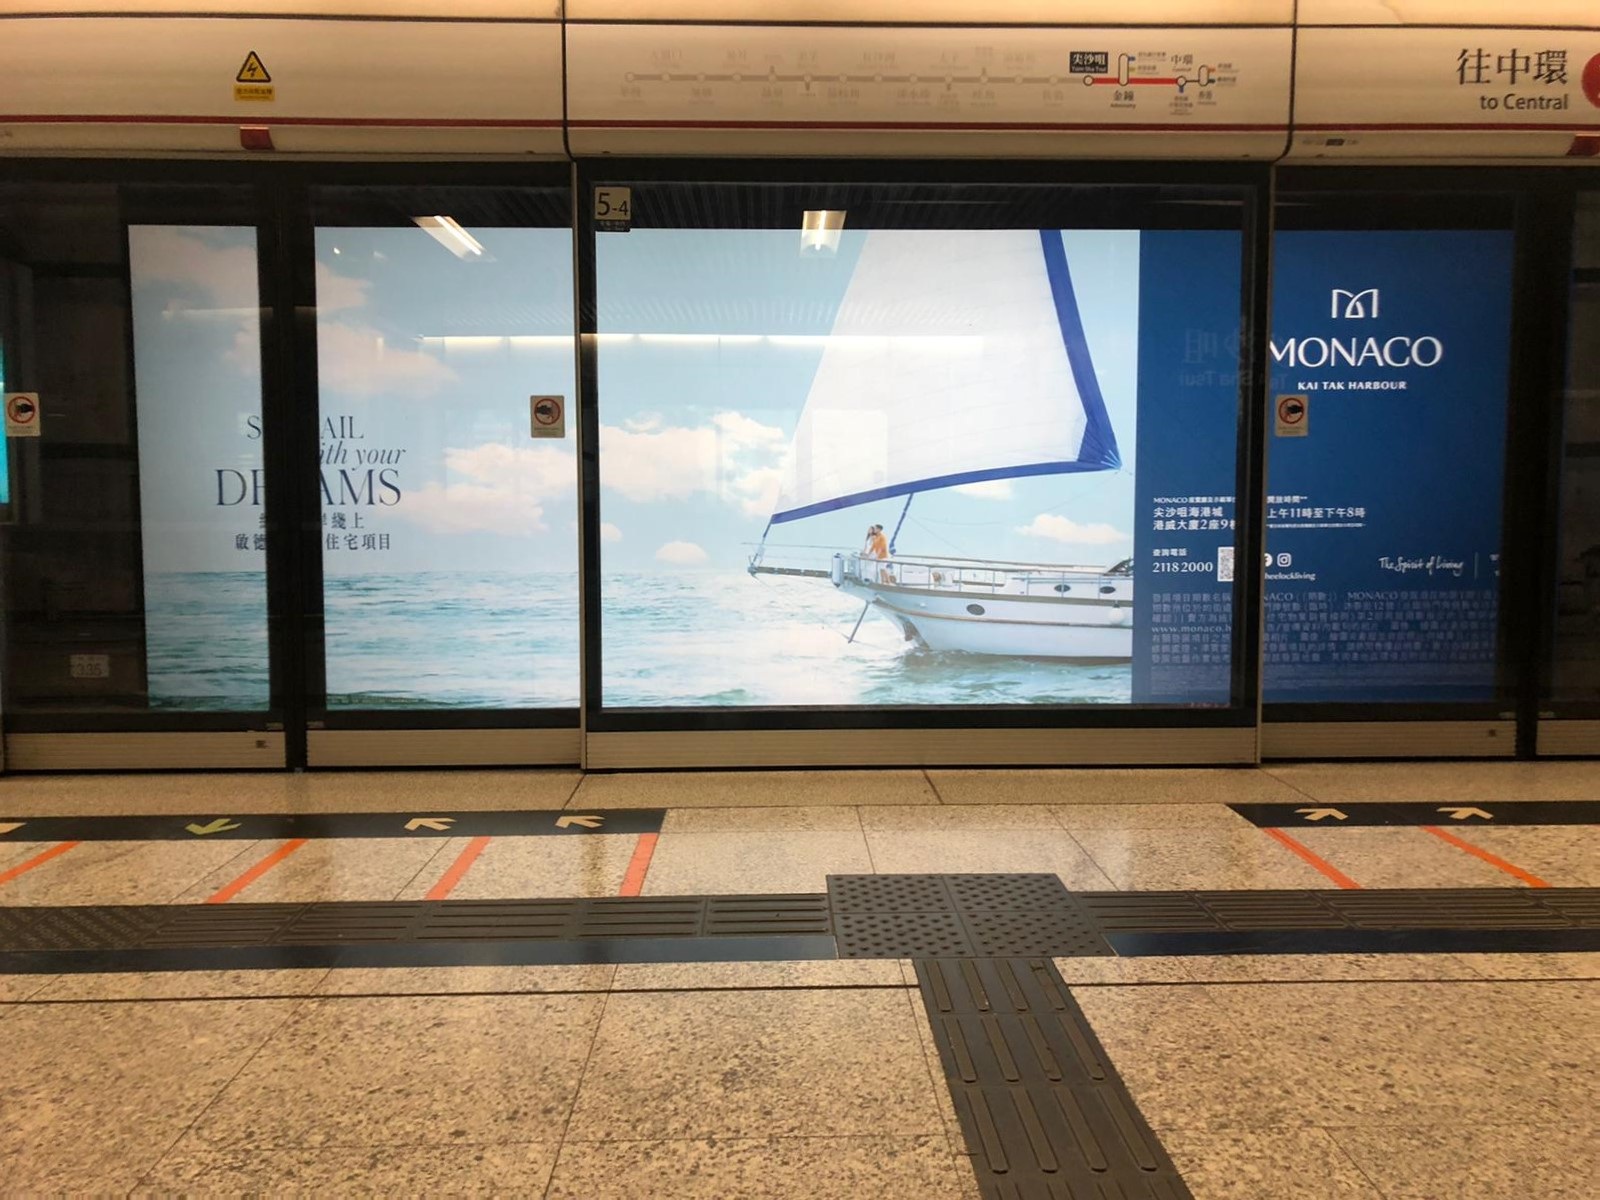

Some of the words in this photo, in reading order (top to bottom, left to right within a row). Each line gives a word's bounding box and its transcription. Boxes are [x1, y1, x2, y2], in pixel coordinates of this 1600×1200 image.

[1456, 48, 1567, 85] 往中環
[1480, 95, 1498, 110] to
[1503, 93, 1569, 110] Central
[597, 192, 628, 216] 5-4
[1269, 336, 1443, 367] MONACO
[1298, 381, 1318, 390] KAI
[1322, 381, 1344, 390] TAK
[1348, 381, 1407, 390] HARBOUR
[319, 441, 347, 465] ith
[352, 447, 406, 471] your
[1266, 507, 1365, 518] 上午11時至下午8時
[1152, 562, 1179, 572] 2118
[1181, 561, 1213, 572] 2000
